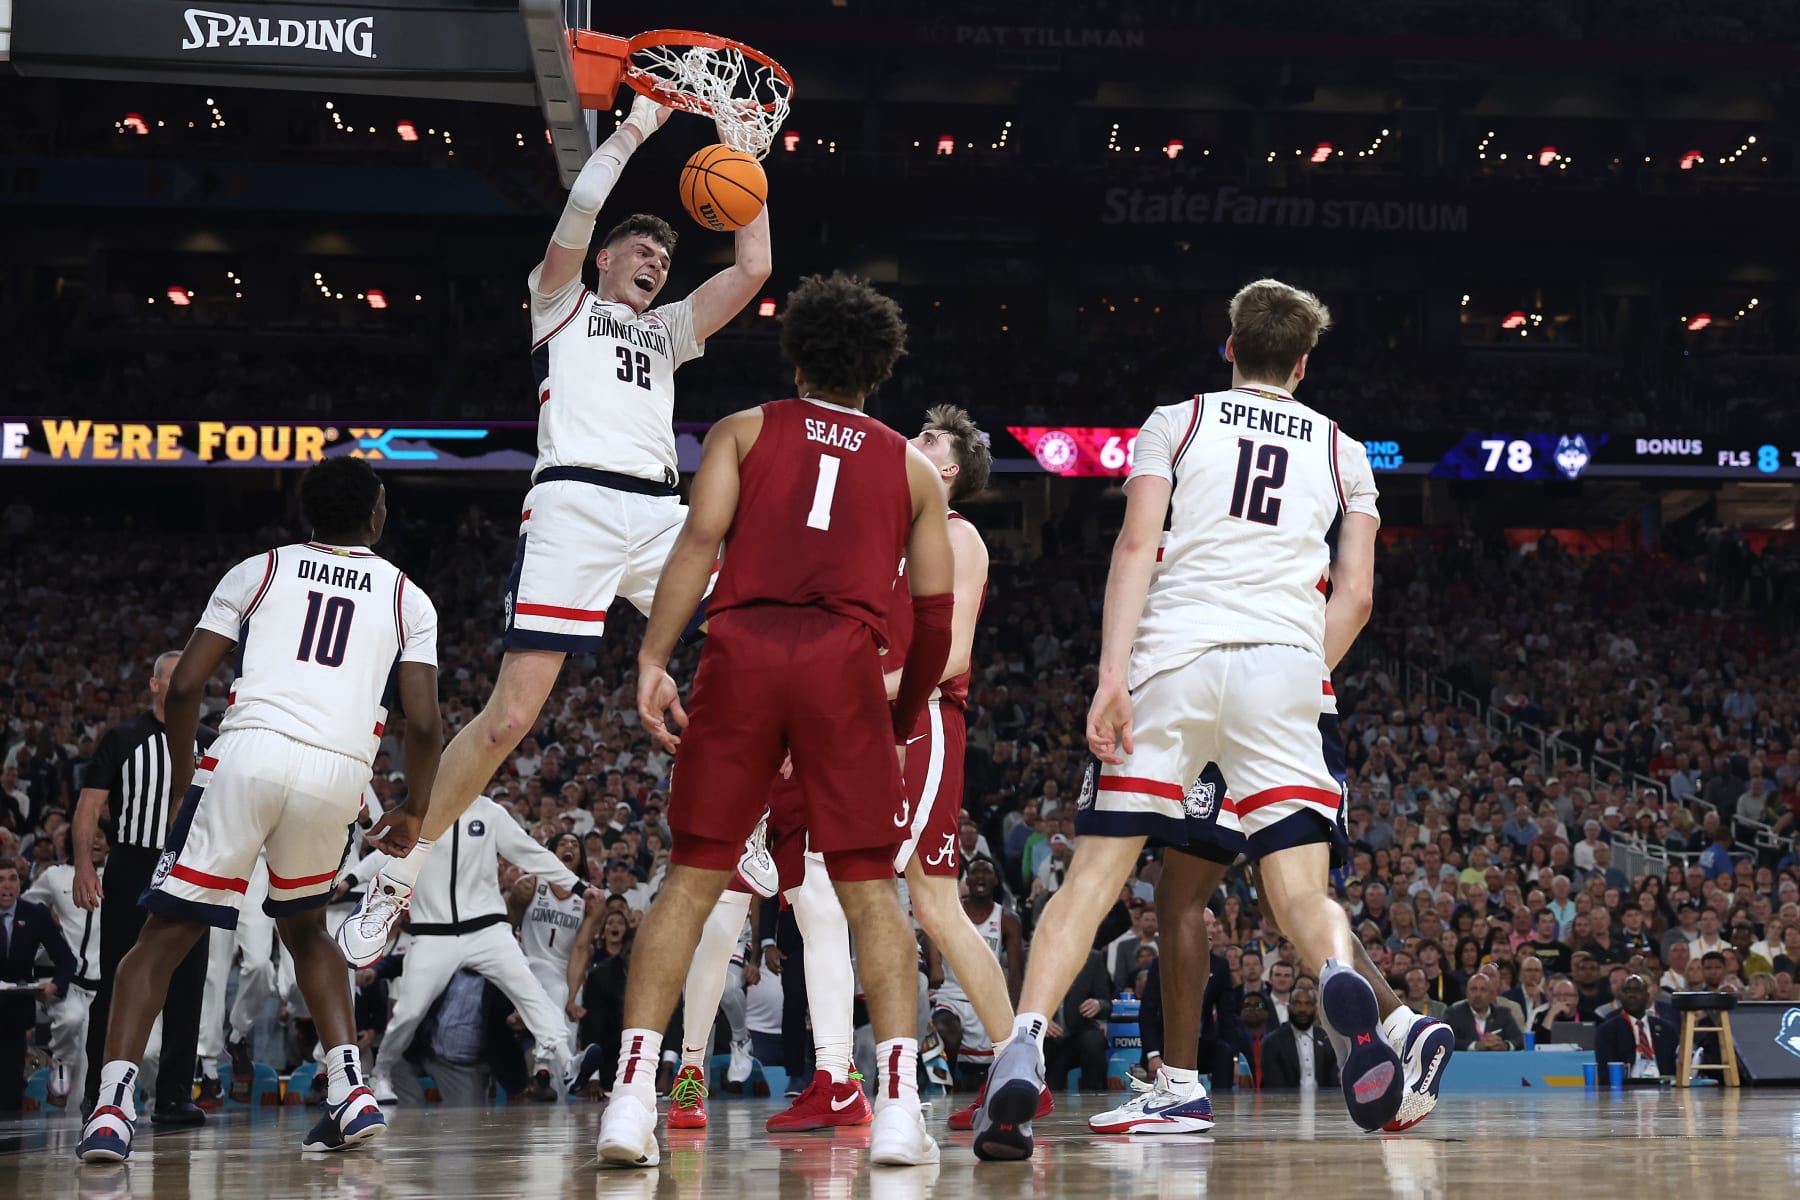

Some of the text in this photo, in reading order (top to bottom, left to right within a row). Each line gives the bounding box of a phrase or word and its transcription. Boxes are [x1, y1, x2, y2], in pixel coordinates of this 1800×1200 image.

[182, 8, 374, 58] SPALDING
[955, 25, 1010, 45] PAT
[1018, 26, 1145, 48] TILLMAN
[1322, 199, 1468, 232] STADIUM
[587, 315, 669, 361] CONNECTICUT
[615, 345, 651, 391] 32
[42, 420, 184, 460] WERE
[805, 418, 867, 452] SEARS
[1219, 401, 1313, 442] SPENCER
[1480, 439, 1533, 473] 78
[1635, 438, 1703, 455] BONUS
[1717, 450, 1751, 467] FLS
[1757, 444, 1780, 474] 8
[806, 453, 841, 531] 1
[1229, 436, 1289, 527] 12
[298, 559, 372, 593] DIARRA
[296, 590, 356, 668] 10
[548, 927, 557, 948] 1
